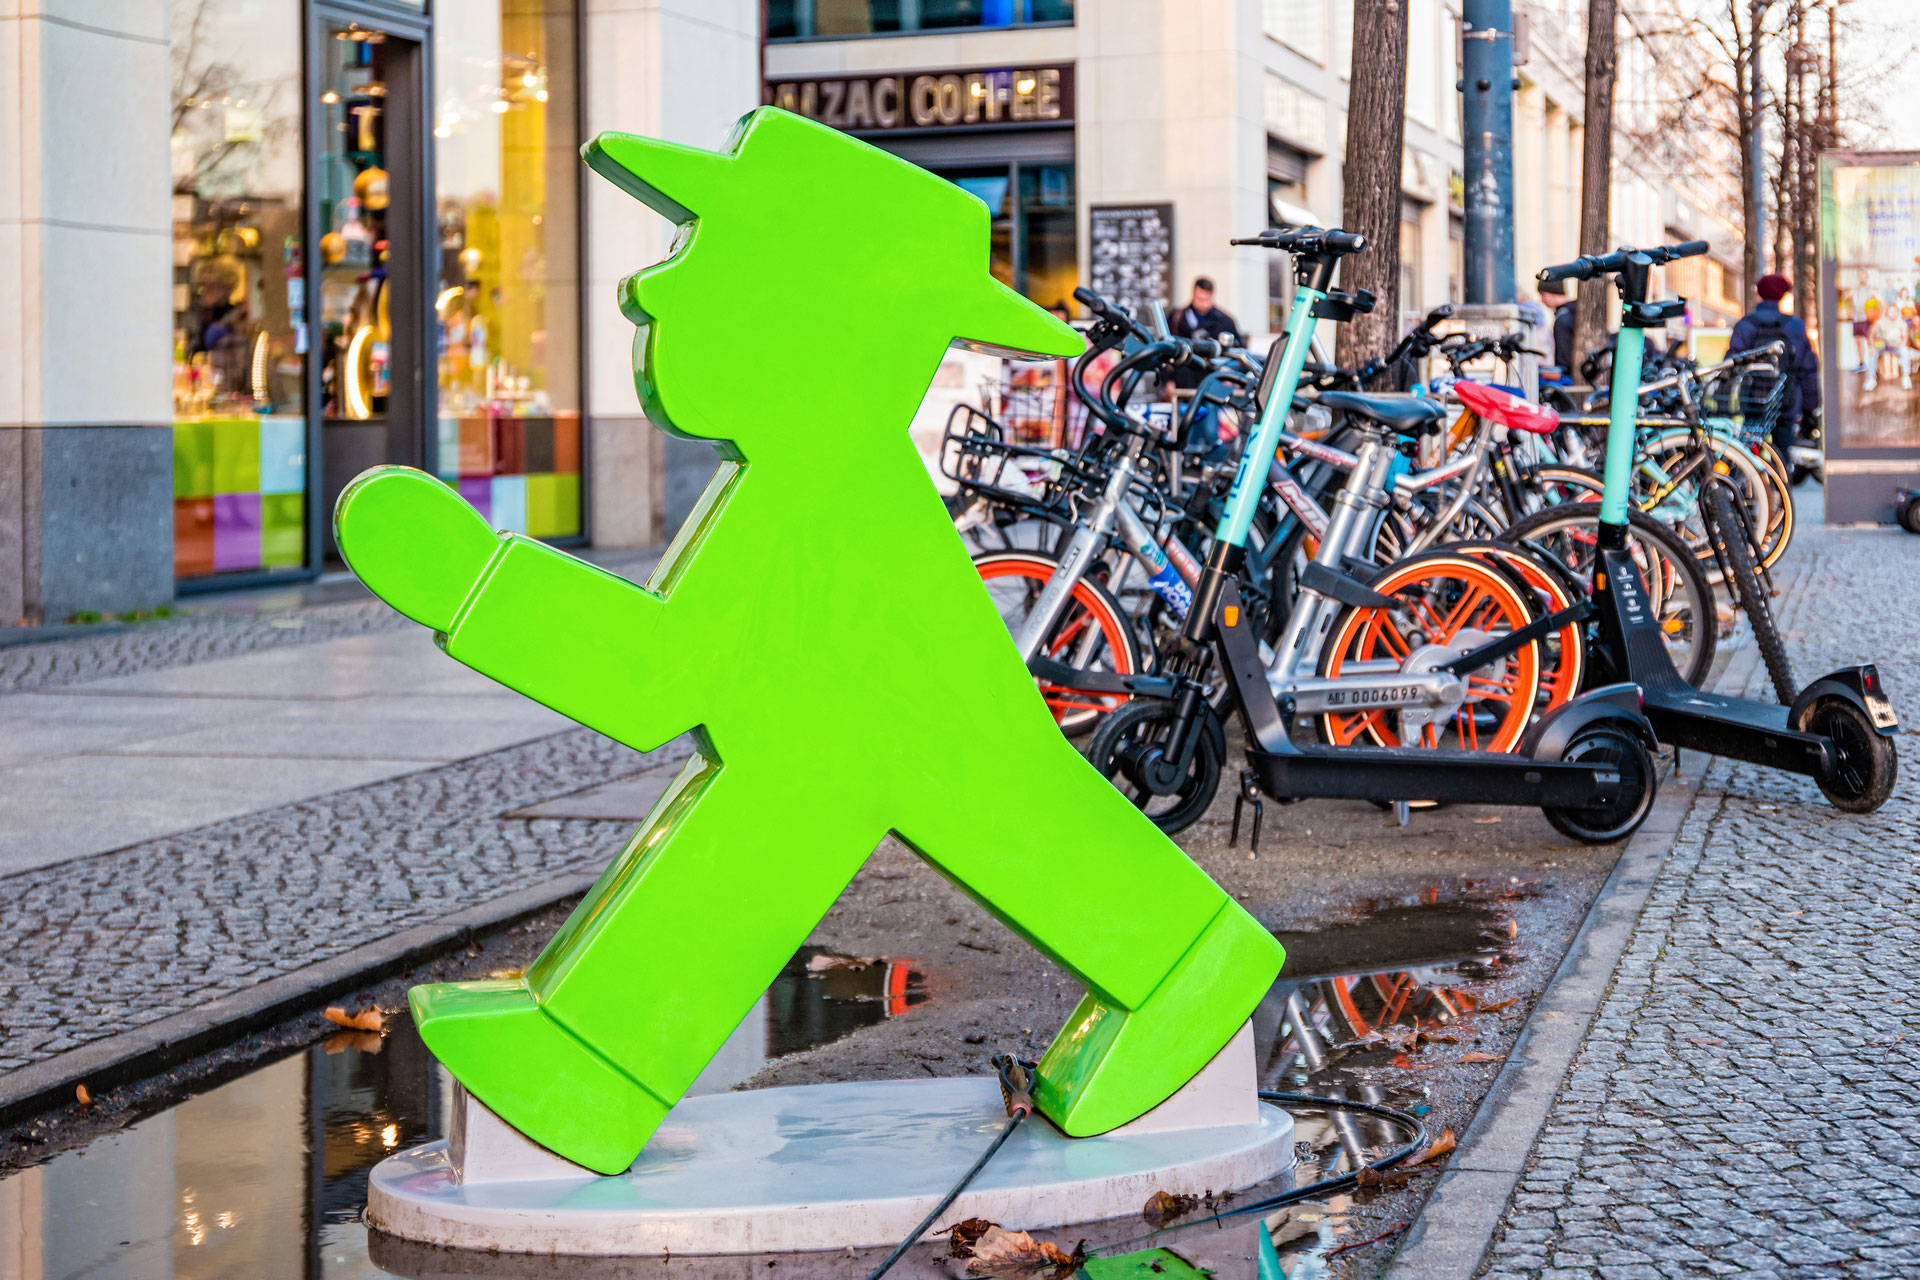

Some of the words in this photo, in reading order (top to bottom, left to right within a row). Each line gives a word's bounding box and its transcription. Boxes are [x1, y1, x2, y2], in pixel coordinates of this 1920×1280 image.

[763, 78, 897, 128] ALZAC
[910, 70, 1060, 127] COFFEE
[1351, 687, 1418, 704] 0006099
